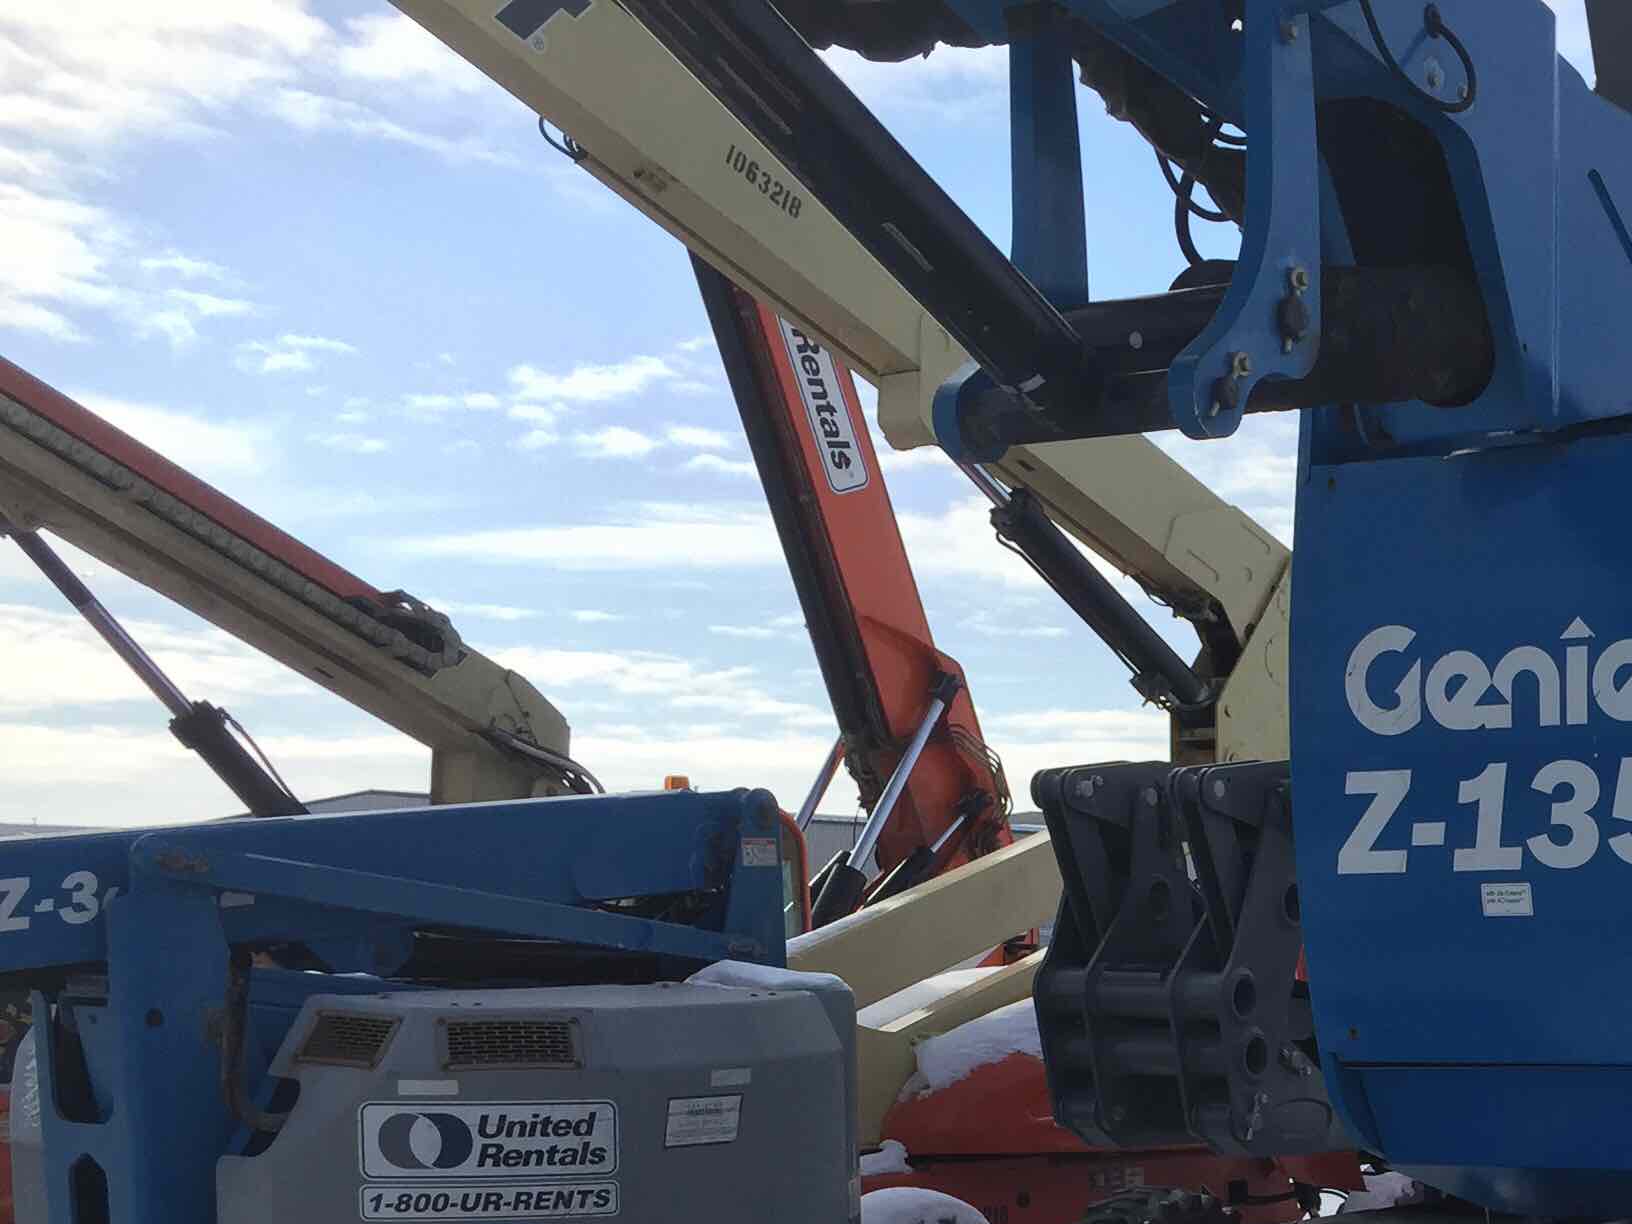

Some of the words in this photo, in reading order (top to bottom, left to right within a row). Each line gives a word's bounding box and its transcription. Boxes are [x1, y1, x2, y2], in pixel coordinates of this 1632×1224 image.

[725, 143, 802, 219] 1063218
[0, 870, 120, 932] Z-3
[477, 1111, 598, 1139] United
[476, 1141, 608, 1168] Rentals
[368, 1189, 611, 1213] 1-800-UR-RENTS
